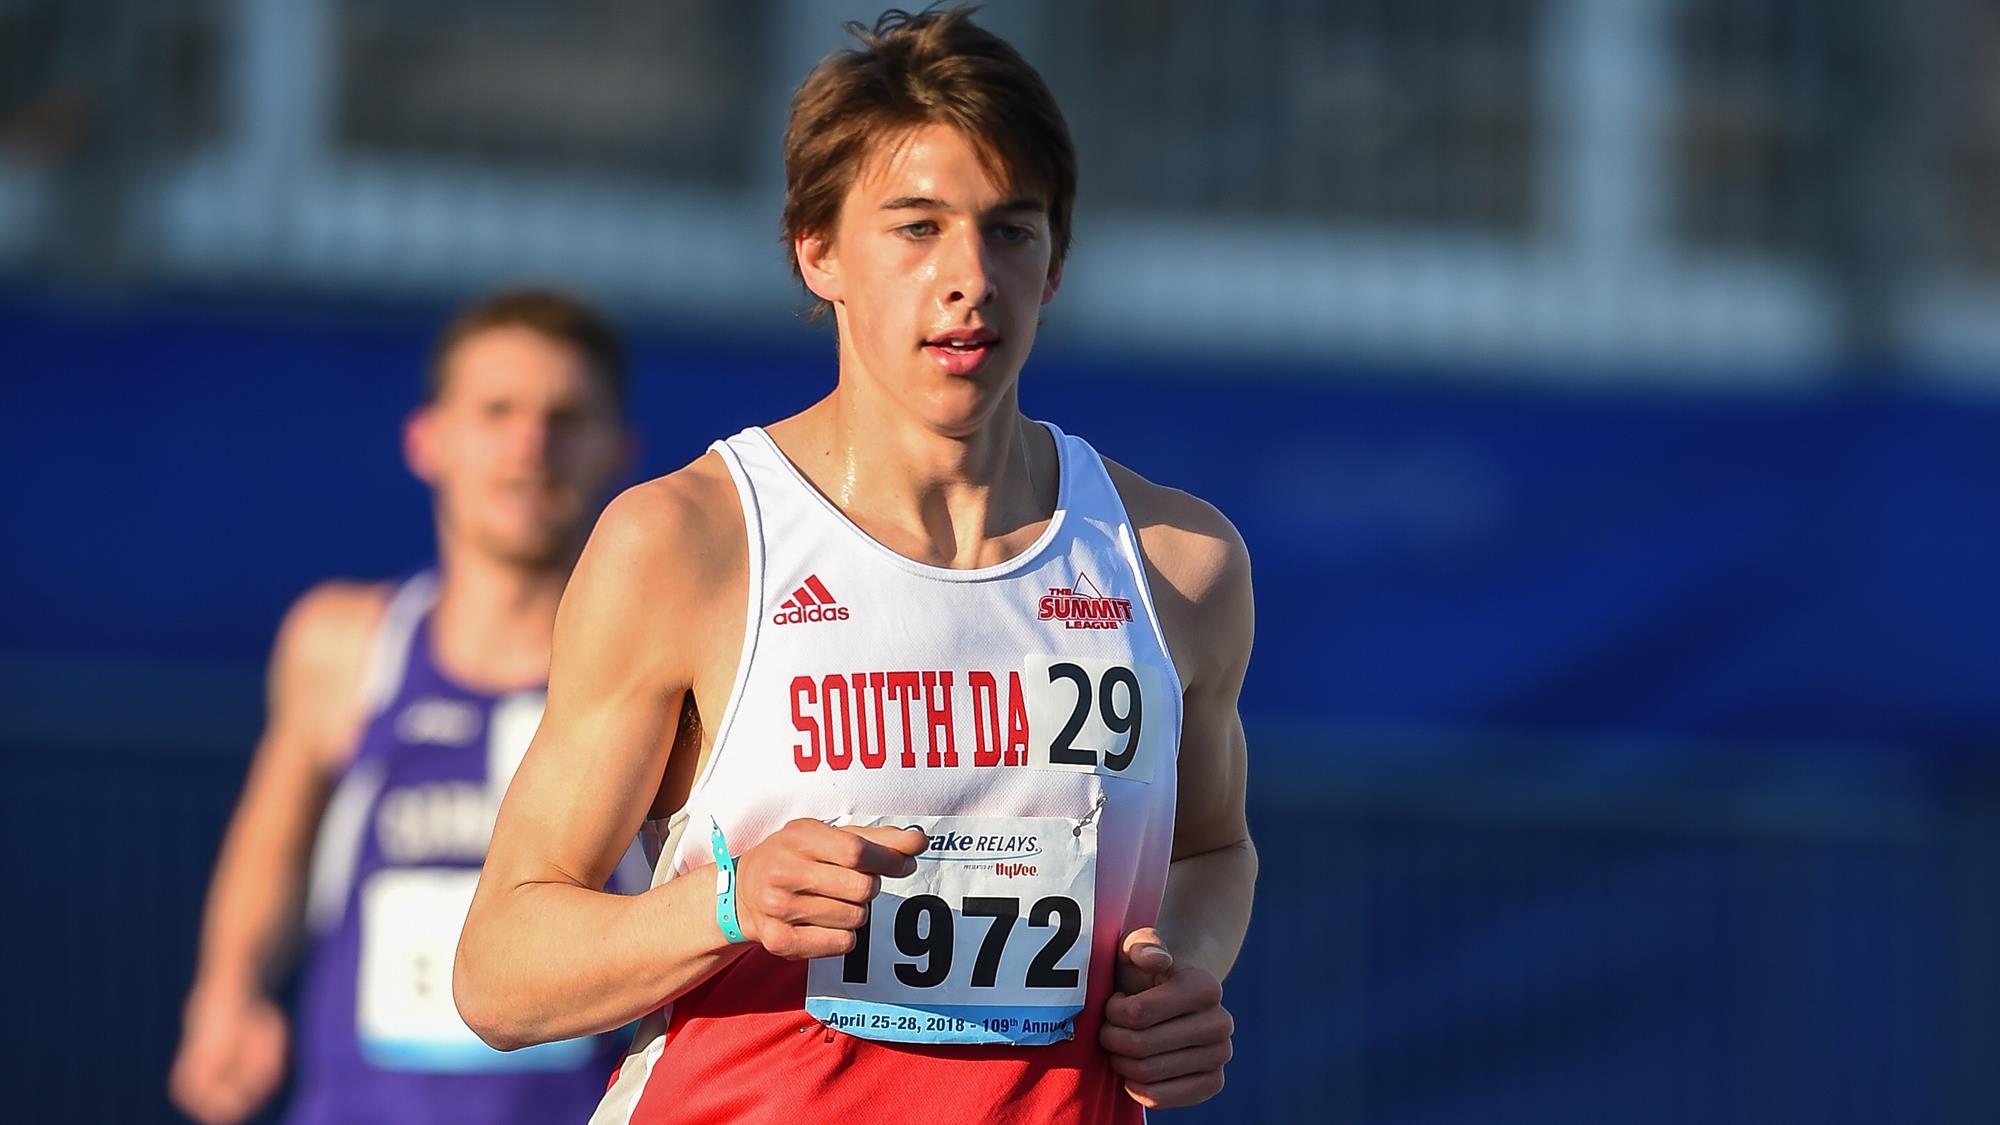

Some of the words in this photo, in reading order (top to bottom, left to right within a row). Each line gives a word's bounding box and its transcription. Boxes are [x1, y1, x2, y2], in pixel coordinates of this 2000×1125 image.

[773, 601, 850, 626] adidas
[1038, 597, 1134, 622] SUMMIT
[1065, 621, 1119, 630] LEAGUE
[789, 670, 959, 773] SOUTH
[1048, 662, 1143, 772] 29
[904, 825, 974, 851] rake
[829, 1011, 866, 1029] April
[871, 1014, 921, 1034] 25-28,
[926, 1016, 965, 1032] 2018
[982, 1018, 1019, 1034] 109th
